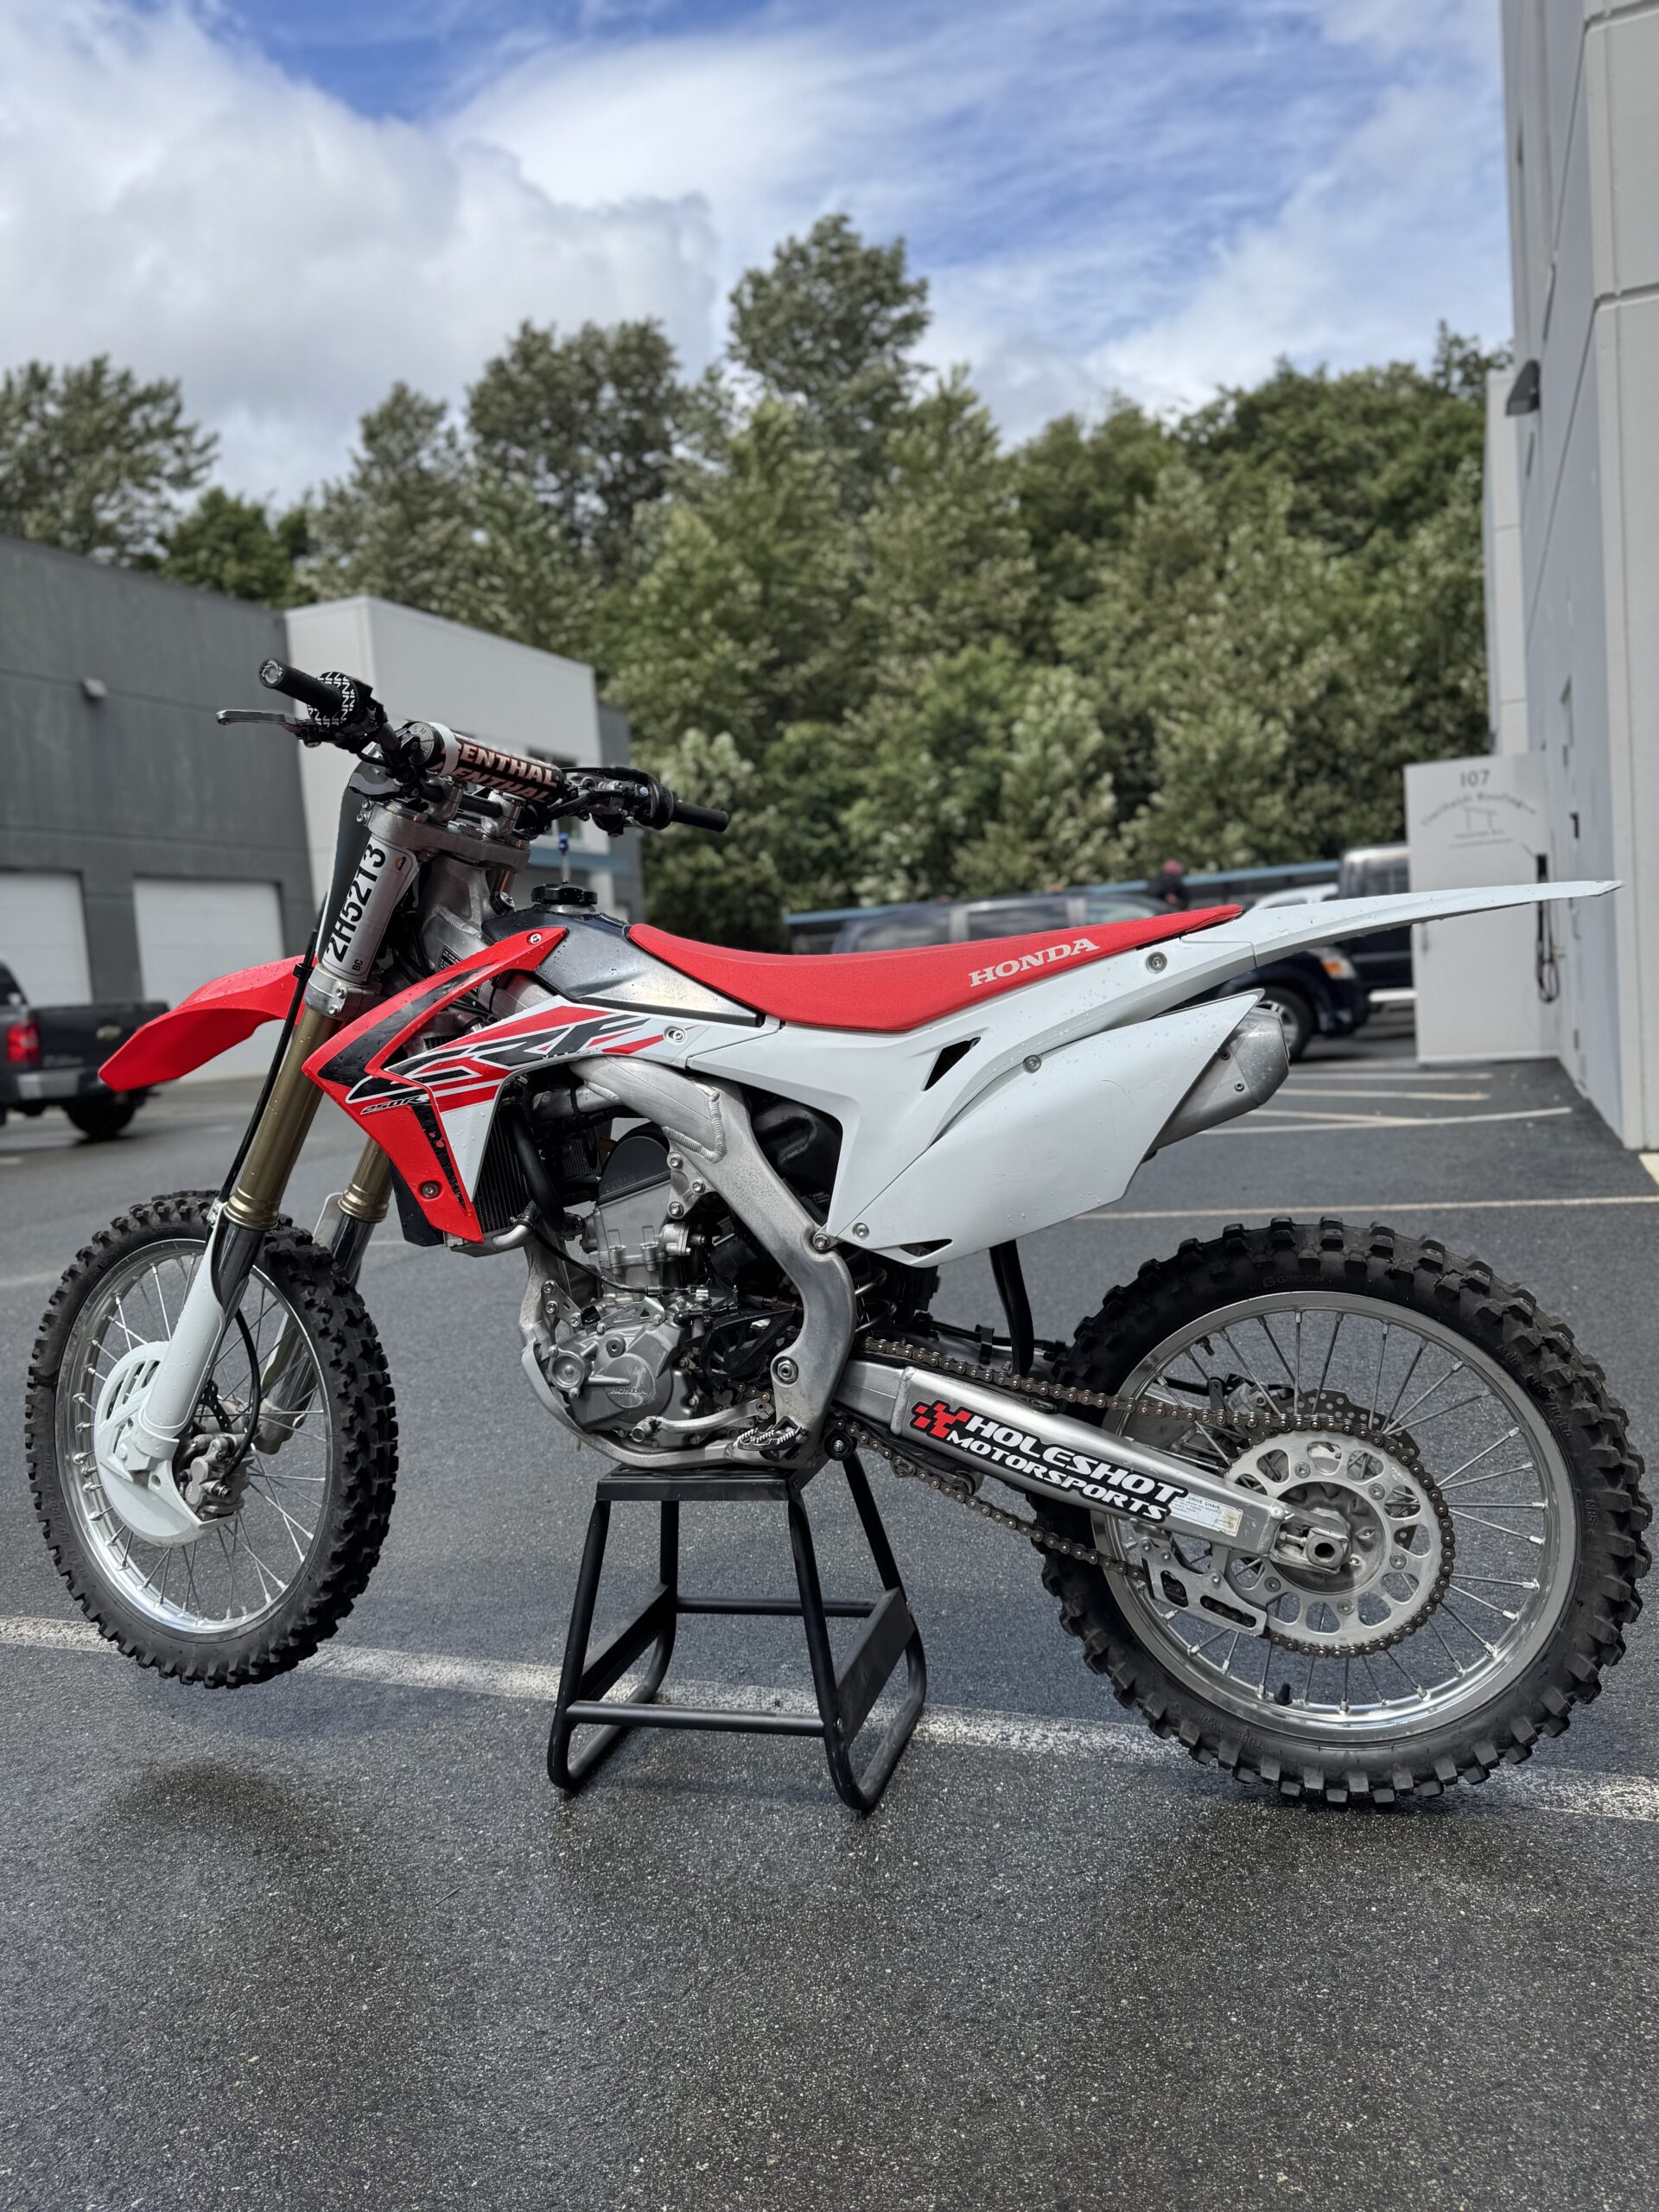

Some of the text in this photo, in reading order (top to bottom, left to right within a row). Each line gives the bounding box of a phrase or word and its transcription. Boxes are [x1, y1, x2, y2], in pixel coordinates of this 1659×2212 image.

[455, 744, 558, 788] ENTHAL
[1460, 769, 1491, 787] 107
[352, 959, 364, 972] BC
[968, 938, 1100, 988] HONDA
[607, 1387, 649, 1396] HONDA
[946, 1430, 1167, 1521] MOTORSPORTS
[964, 1415, 1185, 1503] HOLESHOT
